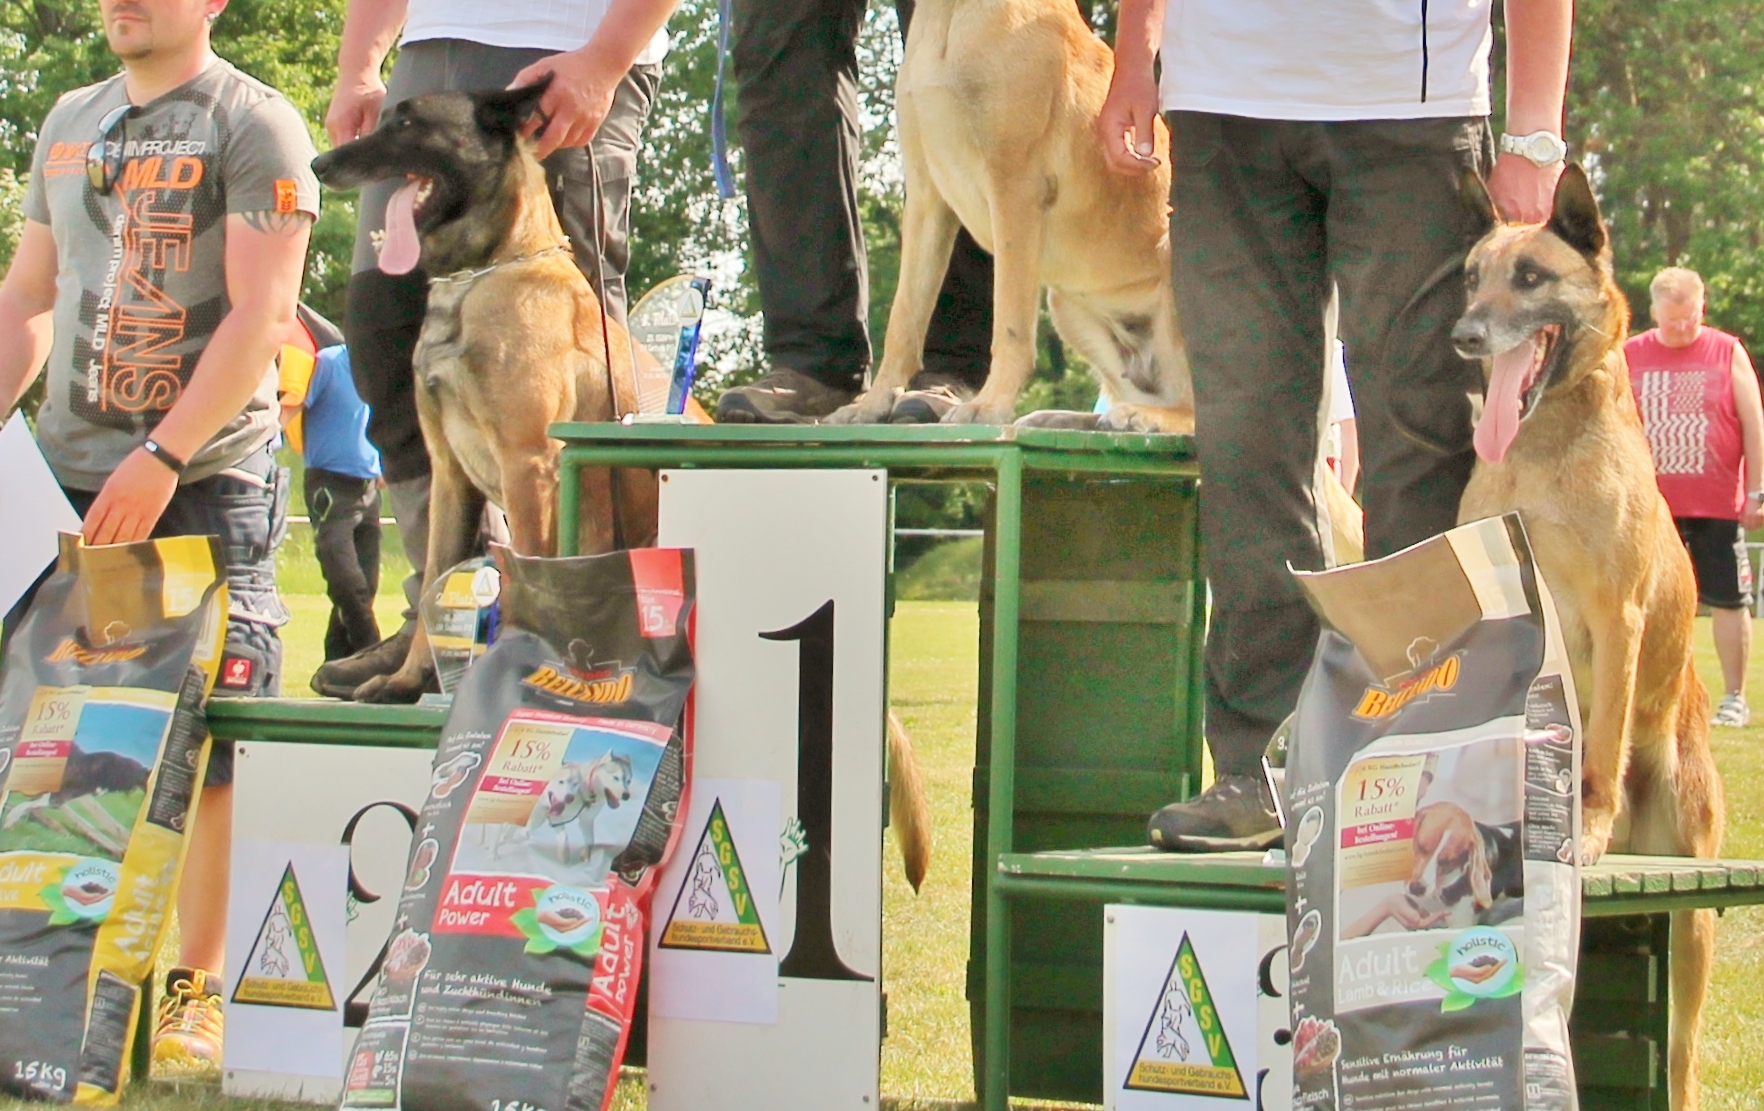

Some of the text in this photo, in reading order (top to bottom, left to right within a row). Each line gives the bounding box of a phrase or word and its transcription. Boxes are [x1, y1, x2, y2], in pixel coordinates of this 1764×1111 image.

[111, 191, 194, 413] JEANS
[87, 358, 103, 403] Jeans
[641, 605, 664, 632] 15
[37, 700, 71, 722] 15%
[510, 739, 552, 762] 15%
[757, 599, 875, 982] 1
[1356, 776, 1405, 801] 15%
[0, 861, 47, 884] dult
[75, 867, 116, 883] holistic
[443, 880, 517, 908] Adult
[548, 892, 592, 910] holistic
[438, 909, 491, 926] Power
[592, 902, 626, 999] Adult
[1456, 935, 1507, 957] holistic
[1338, 945, 1420, 984] Adult
[421, 984, 440, 995] und
[423, 969, 552, 996] Für sehr aktive Hunde
[1337, 984, 1374, 1005] Lamb
[1391, 978, 1433, 997] Rice
[1139, 1062, 1169, 1075] Schutz-
[1171, 1065, 1187, 1076] und
[1340, 1044, 1468, 1070] Sensitive Ernährung für
[1341, 1056, 1504, 1085] Hunde mit normaler Aktivität
